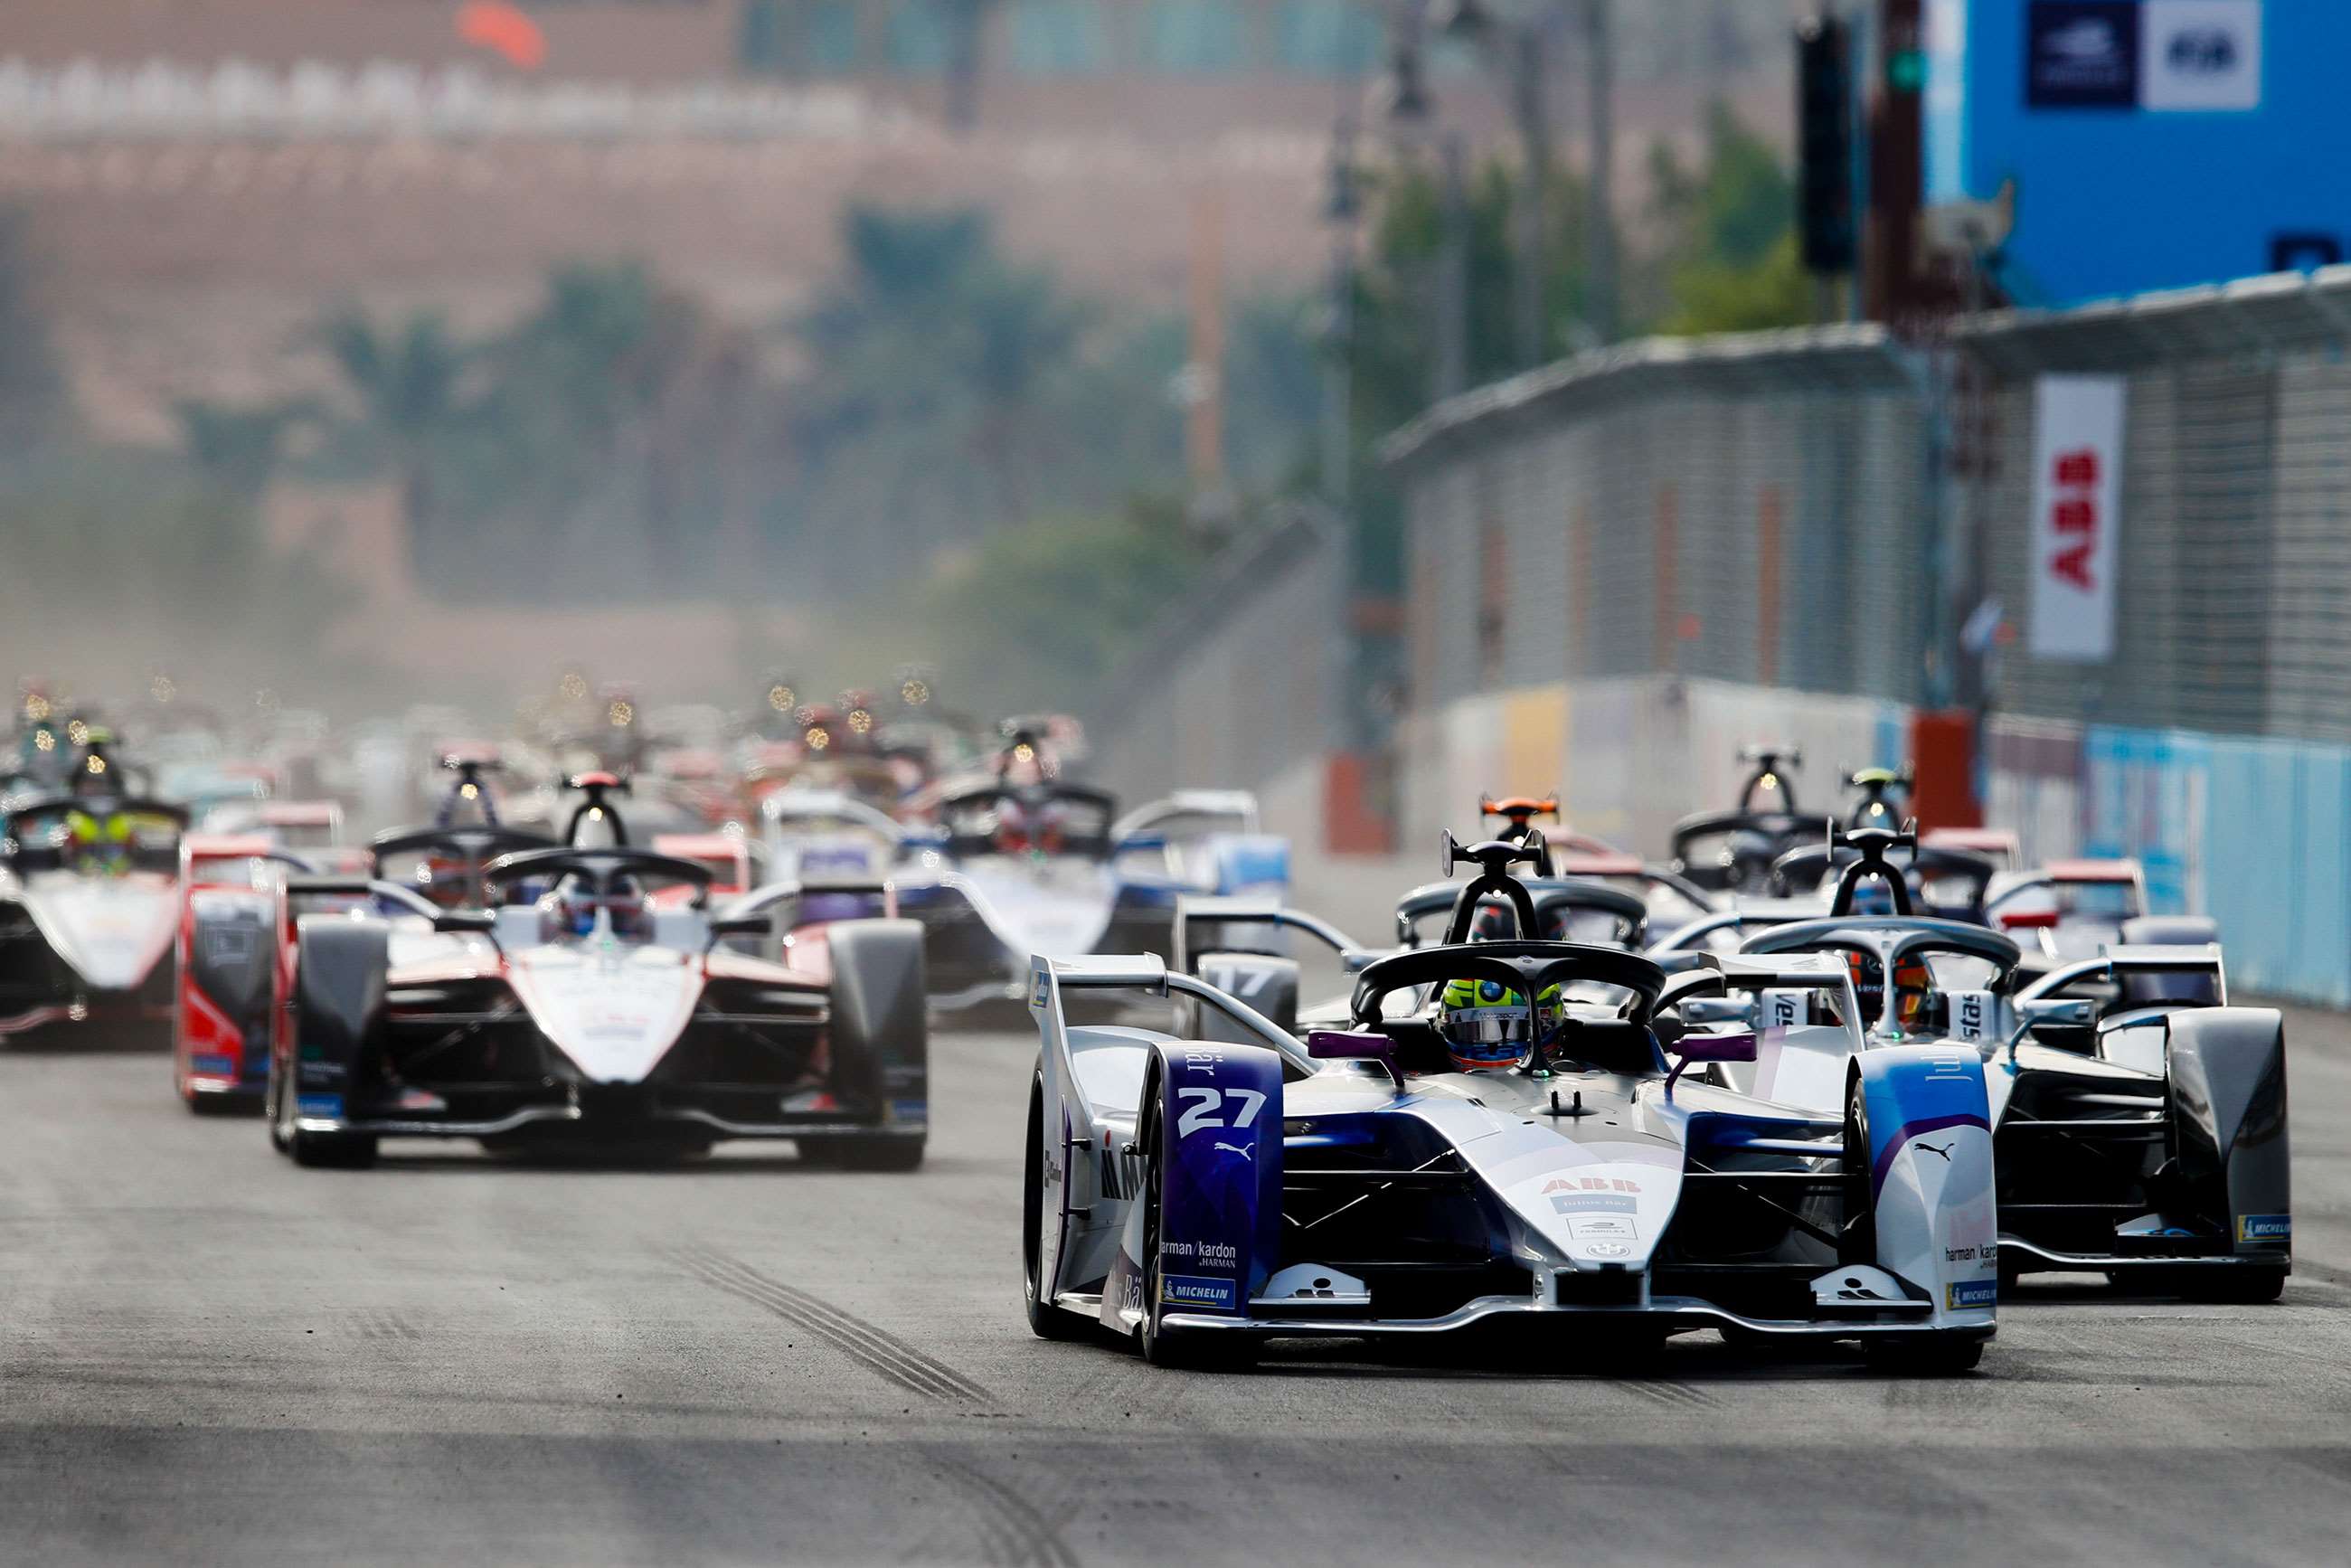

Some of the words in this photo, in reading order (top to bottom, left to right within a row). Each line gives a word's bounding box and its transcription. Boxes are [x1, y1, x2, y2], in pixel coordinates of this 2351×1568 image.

[2050, 447, 2100, 595] ABB
[1207, 965, 1275, 997] 17
[1177, 1087, 1267, 1139] 27
[1541, 1177, 1641, 1195] ABB
[1176, 1285, 1229, 1299] MICHELIN
